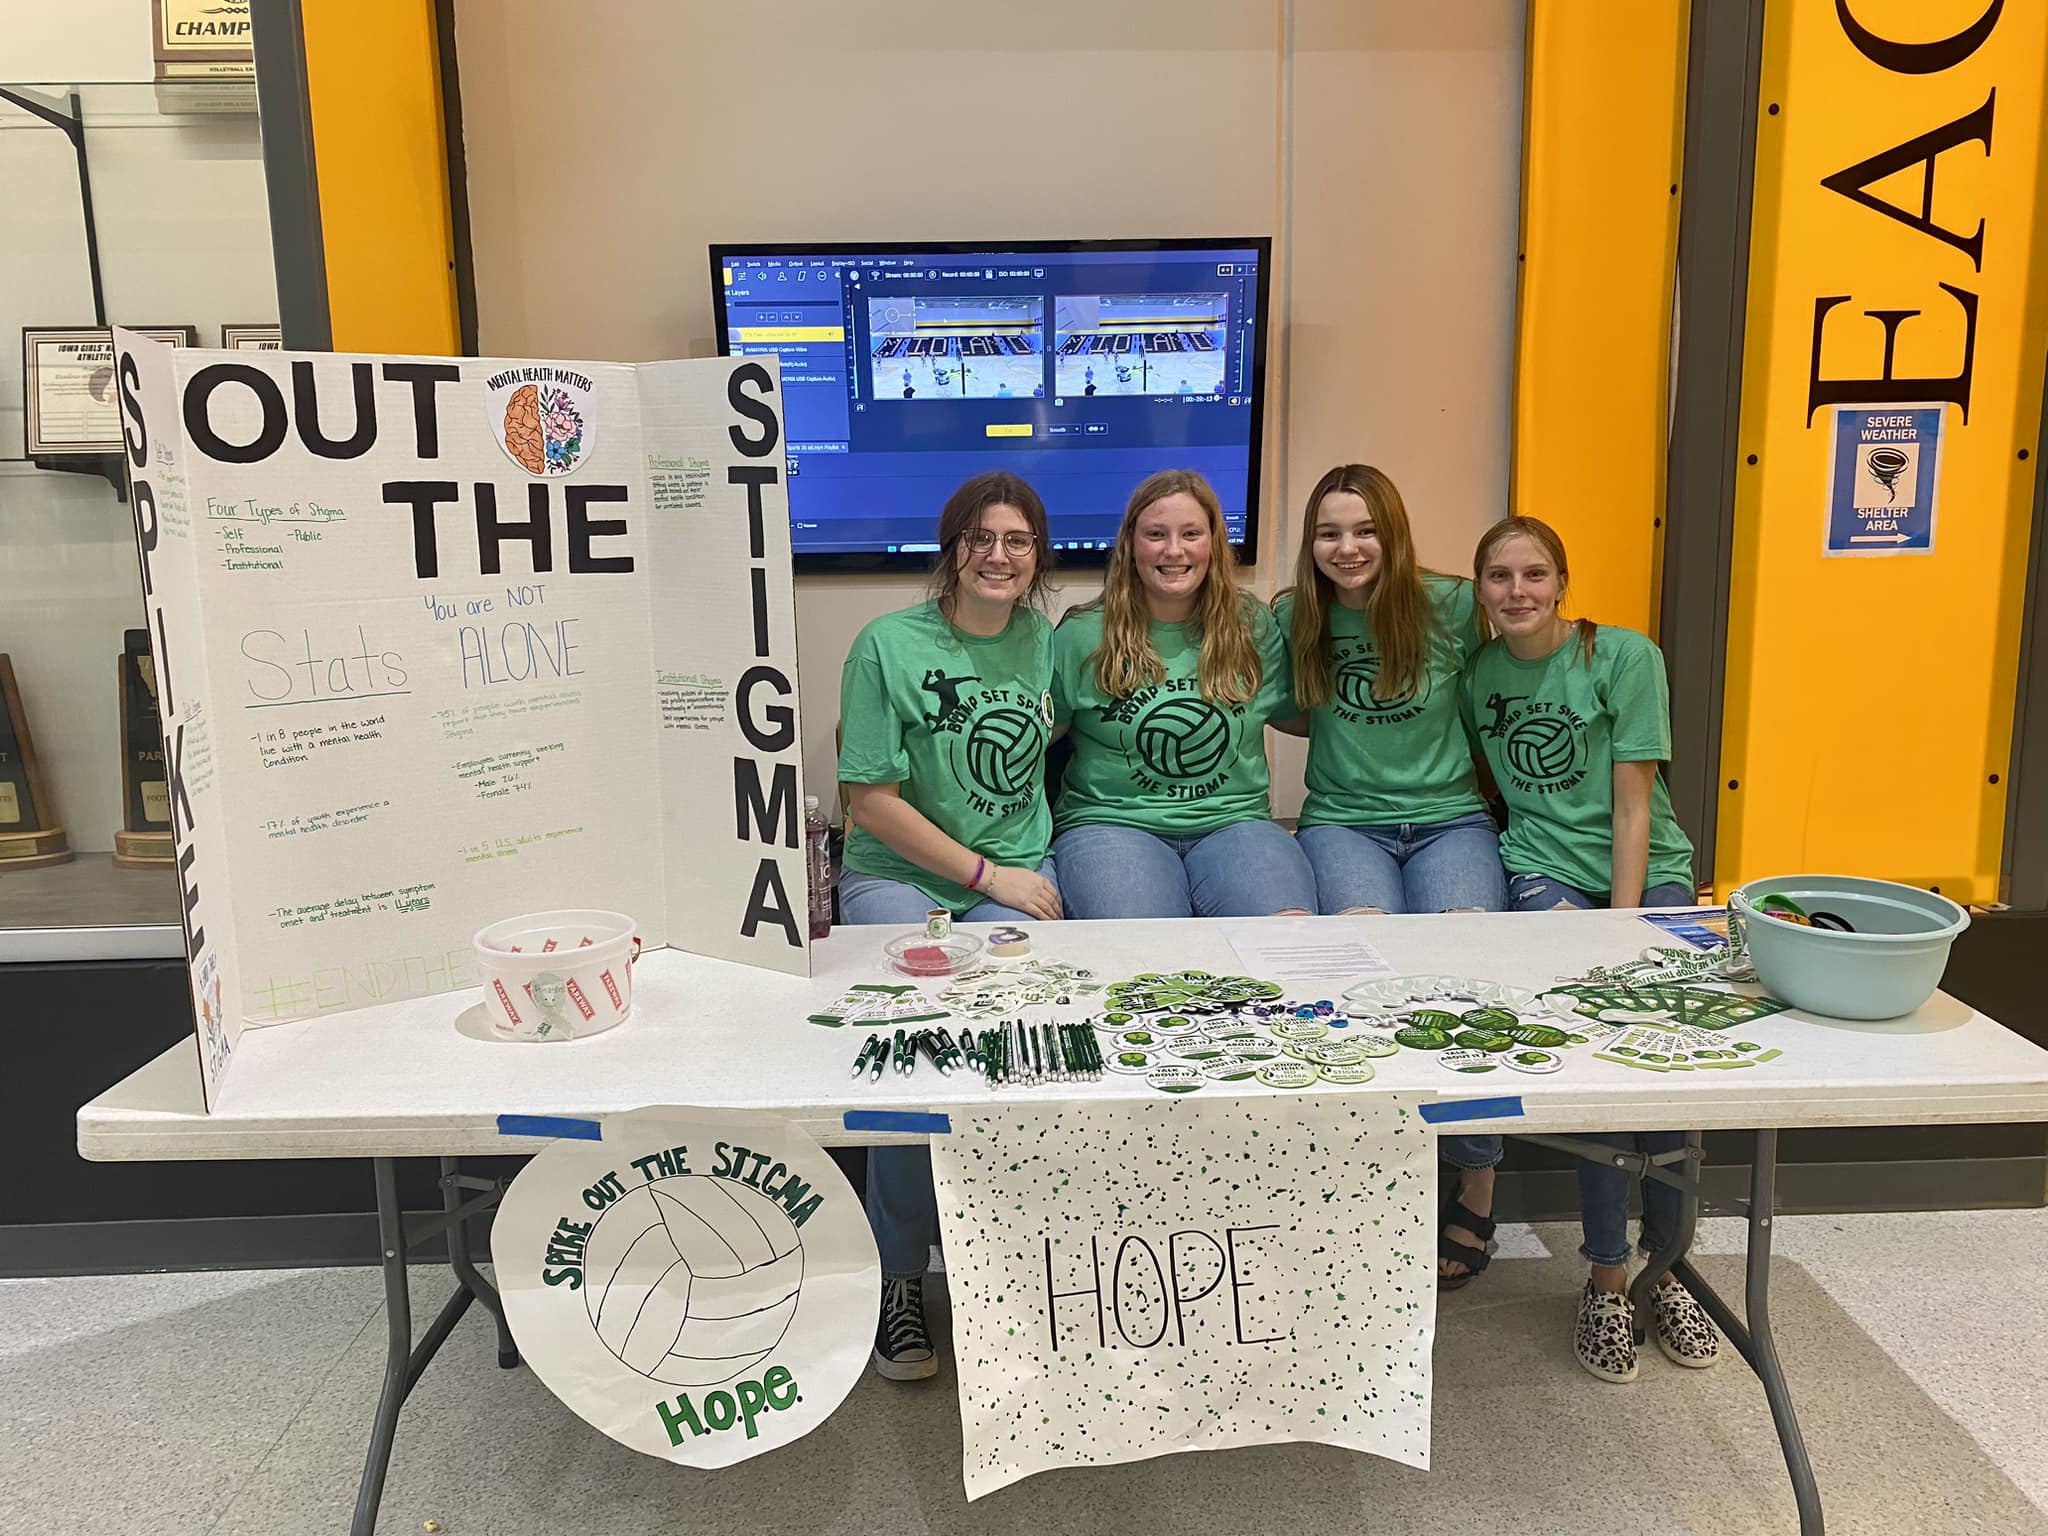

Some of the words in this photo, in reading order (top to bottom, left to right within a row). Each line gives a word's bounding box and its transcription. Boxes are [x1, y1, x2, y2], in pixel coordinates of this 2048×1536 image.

[176, 22, 250, 35] CHAMP
[788, 260, 803, 268] Output
[810, 260, 825, 268] Layout
[58, 344, 79, 353] IOWA
[80, 344, 105, 353] GIRLS'
[77, 353, 112, 361] ATHLETIC
[258, 343, 279, 351] IOWA
[487, 369, 522, 392] MENTAL
[522, 367, 553, 382] HEALTH
[555, 369, 593, 392] MATTERS
[182, 361, 461, 464] OUT
[1867, 416, 1913, 428] SEVERE
[1861, 428, 1917, 441] WEATHER
[207, 497, 238, 517] Four
[244, 499, 283, 525] Types
[289, 503, 300, 515] of
[309, 502, 345, 522] Stigma
[1857, 507, 1908, 519] SHELTER
[382, 480, 635, 579] THE
[1865, 519, 1898, 532] AREA
[424, 595, 458, 621] You
[466, 598, 495, 617] are
[506, 584, 546, 607] NOT
[118, 350, 206, 965] SPIKE
[458, 618, 585, 689] ALONE
[727, 363, 805, 949] STIGMA
[1355, 642, 1376, 654] SE
[241, 624, 408, 701] Stats
[504, 698, 527, 708] with
[528, 692, 557, 705] mental
[946, 695, 979, 735] BUMP
[980, 690, 1010, 704] SET
[1117, 685, 1159, 726] BUMP
[1165, 678, 1198, 693] SET
[1526, 702, 1553, 715] SET
[266, 731, 277, 742] in
[279, 728, 287, 740] 8
[292, 726, 323, 742] people
[328, 724, 338, 733] in
[341, 721, 357, 731] the
[360, 714, 386, 728] world
[442, 717, 469, 729] report
[1332, 705, 1361, 724] THE
[1365, 705, 1426, 725] STIGMA
[259, 746, 277, 757] live
[282, 742, 303, 753] with
[308, 741, 316, 750] a
[320, 734, 351, 748] mental
[354, 729, 382, 742] health
[536, 741, 565, 754] seeking
[263, 754, 309, 769] Condition
[458, 767, 486, 780] mental
[487, 761, 512, 774] health
[512, 755, 541, 768] support
[1130, 769, 1163, 794] THE
[1167, 772, 1230, 799] STIGMA
[1510, 775, 1534, 793] THE
[1537, 770, 1588, 795] STIGMA
[291, 816, 301, 827] of
[307, 811, 333, 826] youth
[335, 801, 381, 818] experience
[384, 799, 391, 807] a
[965, 790, 996, 817] THE
[1001, 781, 1034, 818] STIGM
[268, 827, 297, 840] mental
[300, 822, 329, 834] health
[331, 813, 369, 828] disorder
[516, 833, 542, 846] adults
[465, 851, 494, 864] mental
[280, 916, 304, 929] onset
[309, 913, 326, 924] and
[330, 904, 373, 919] treatment
[378, 902, 388, 911] is
[404, 895, 431, 913] years
[297, 902, 331, 916] average
[334, 896, 360, 910] delay
[361, 889, 395, 902] between
[398, 881, 437, 898] symptom
[494, 982, 519, 1024] FAREWAY
[567, 980, 594, 1018] FAREWAY
[542, 1216, 593, 1291] SPIKE
[581, 1170, 628, 1211] OUT
[630, 1144, 693, 1182] THE
[711, 1141, 825, 1229] STIGMA
[1044, 1222, 1288, 1352] HOPE
